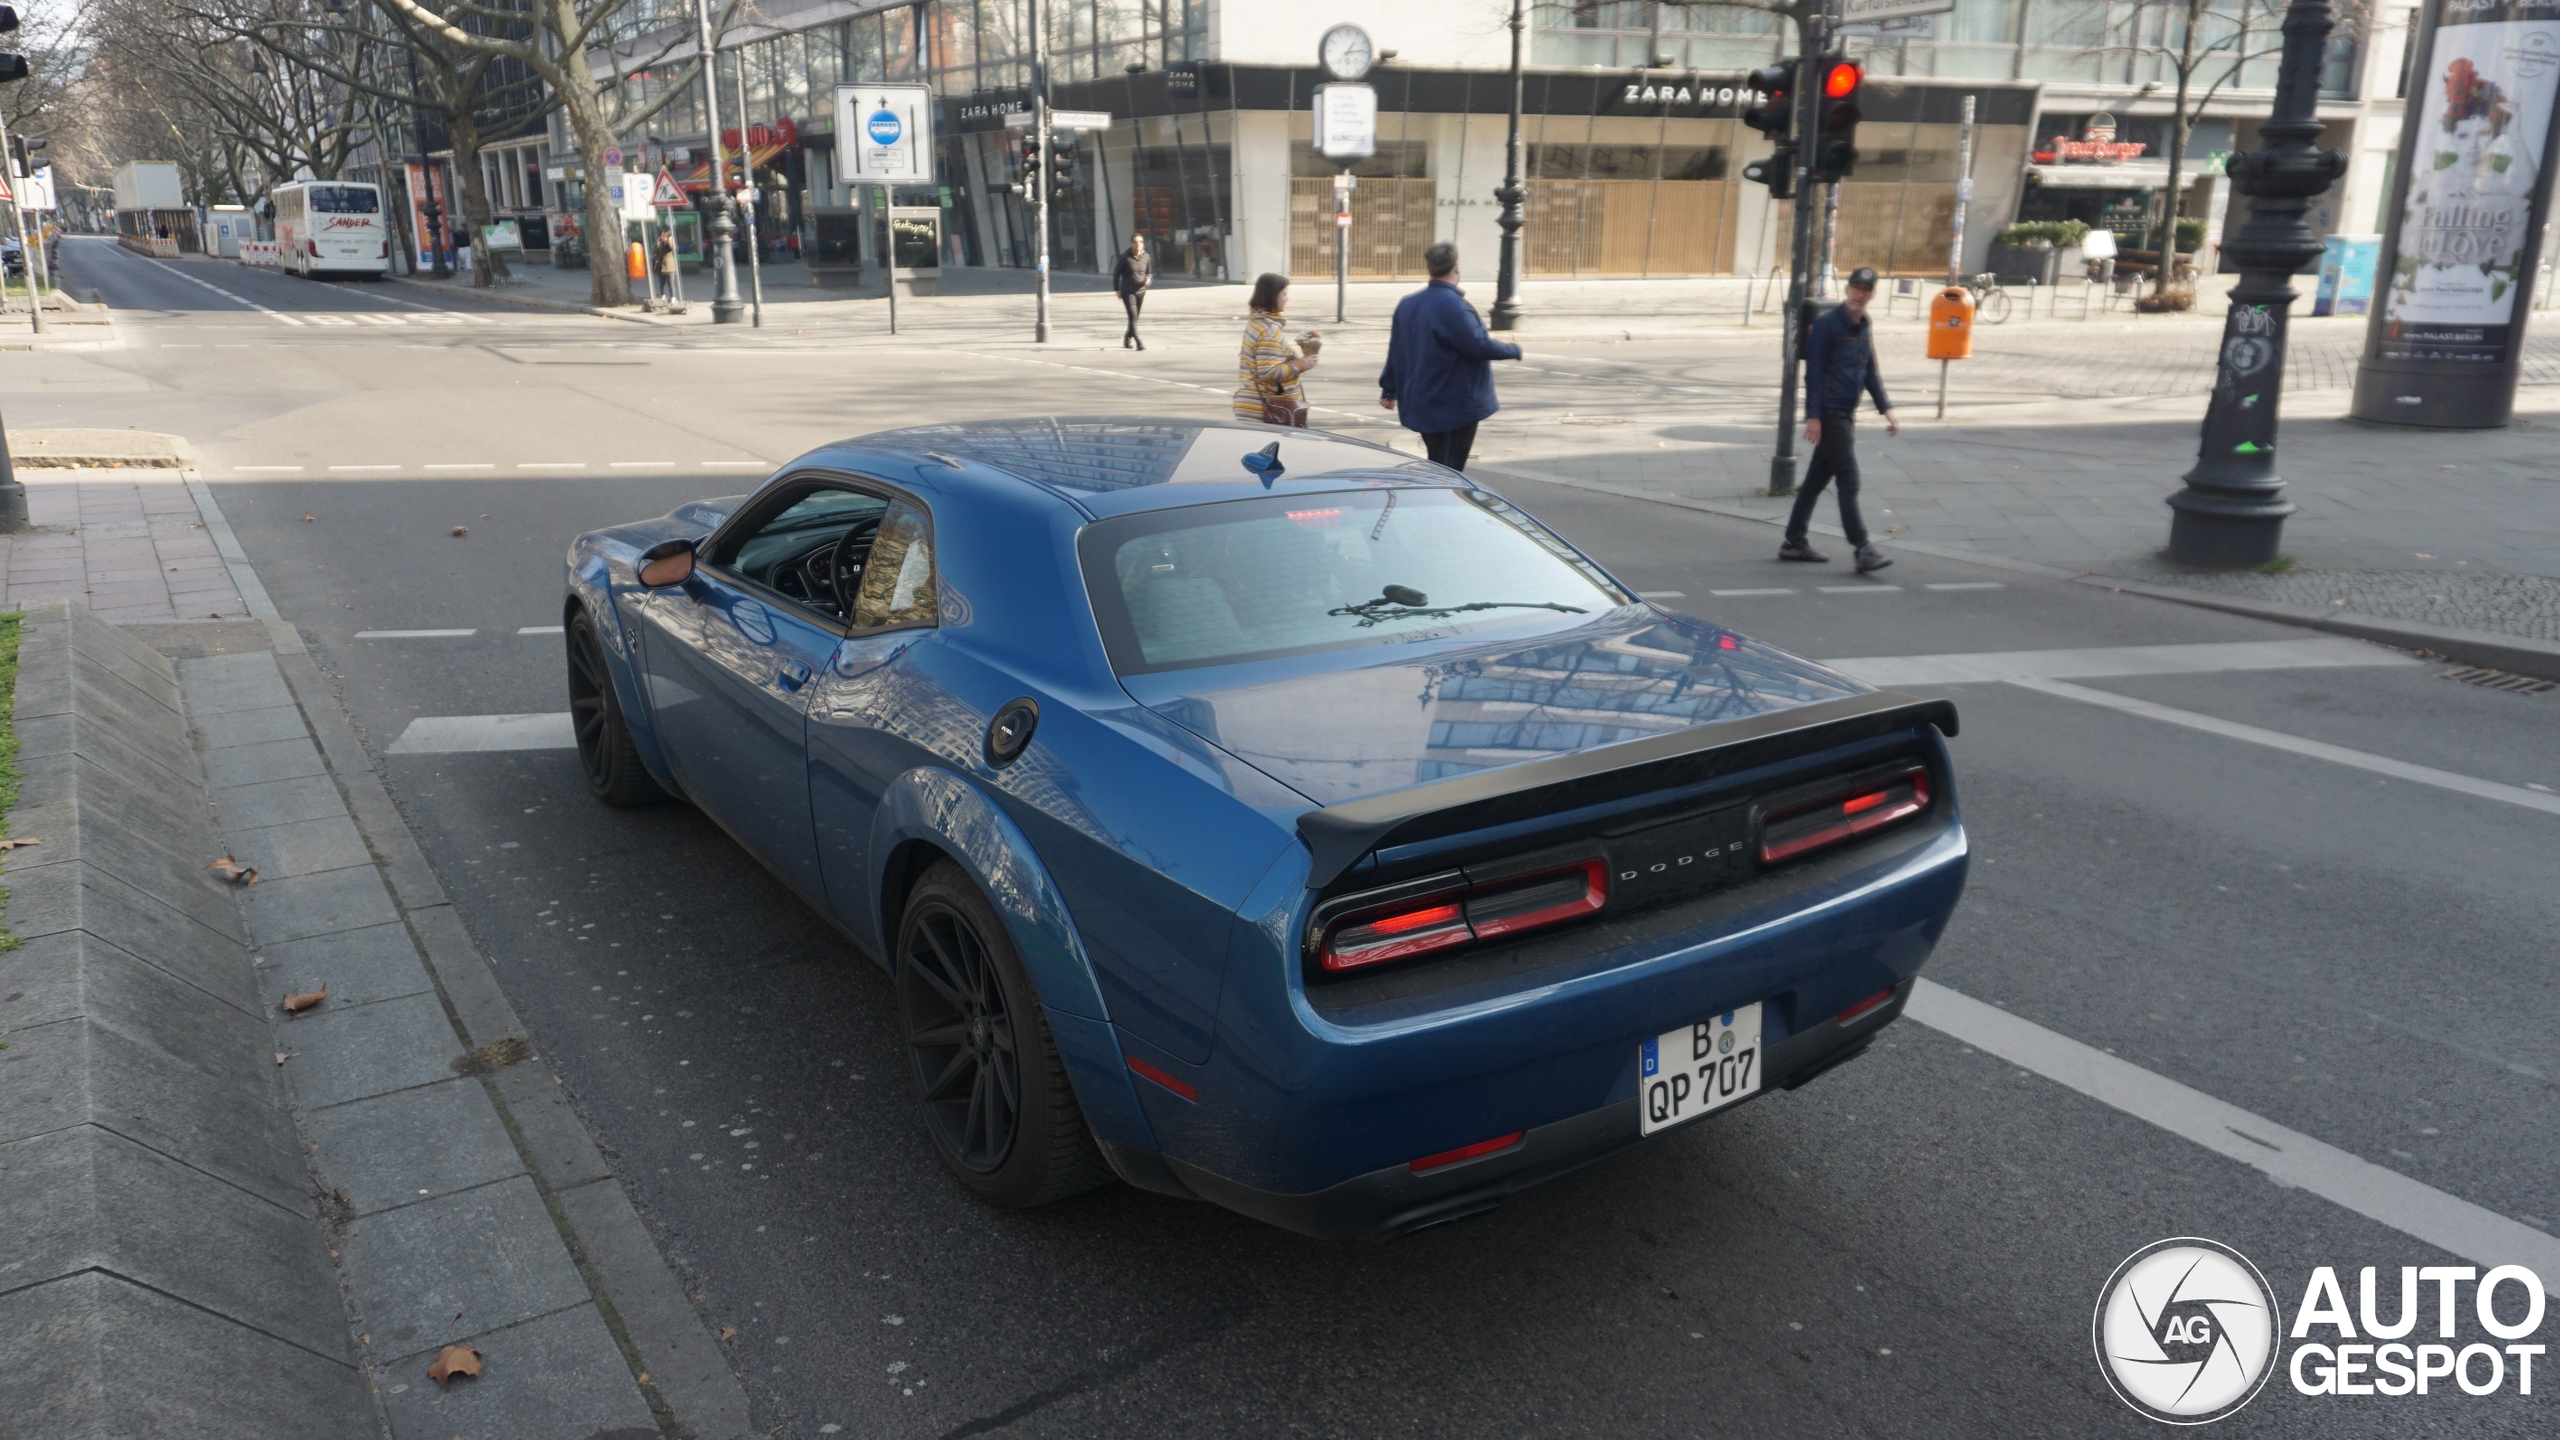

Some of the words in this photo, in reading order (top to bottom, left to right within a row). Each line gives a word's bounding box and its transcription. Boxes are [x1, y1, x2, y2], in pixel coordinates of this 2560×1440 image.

[1169, 71, 1195, 79] ZARA
[1168, 80, 1195, 88] HOME
[1625, 85, 1692, 103] ZARA
[1700, 87, 1768, 107] HOME
[960, 106, 988, 119] ZARA
[991, 101, 1023, 116] HOME
[323, 217, 380, 231] SANDER
[303, 313, 463, 325] BUS
[1621, 841, 1743, 880] DODGE
[1693, 1020, 1712, 1061] B
[1646, 1058, 1654, 1071] D
[1649, 1072, 1690, 1123] QP
[1699, 1047, 1755, 1105] 707
